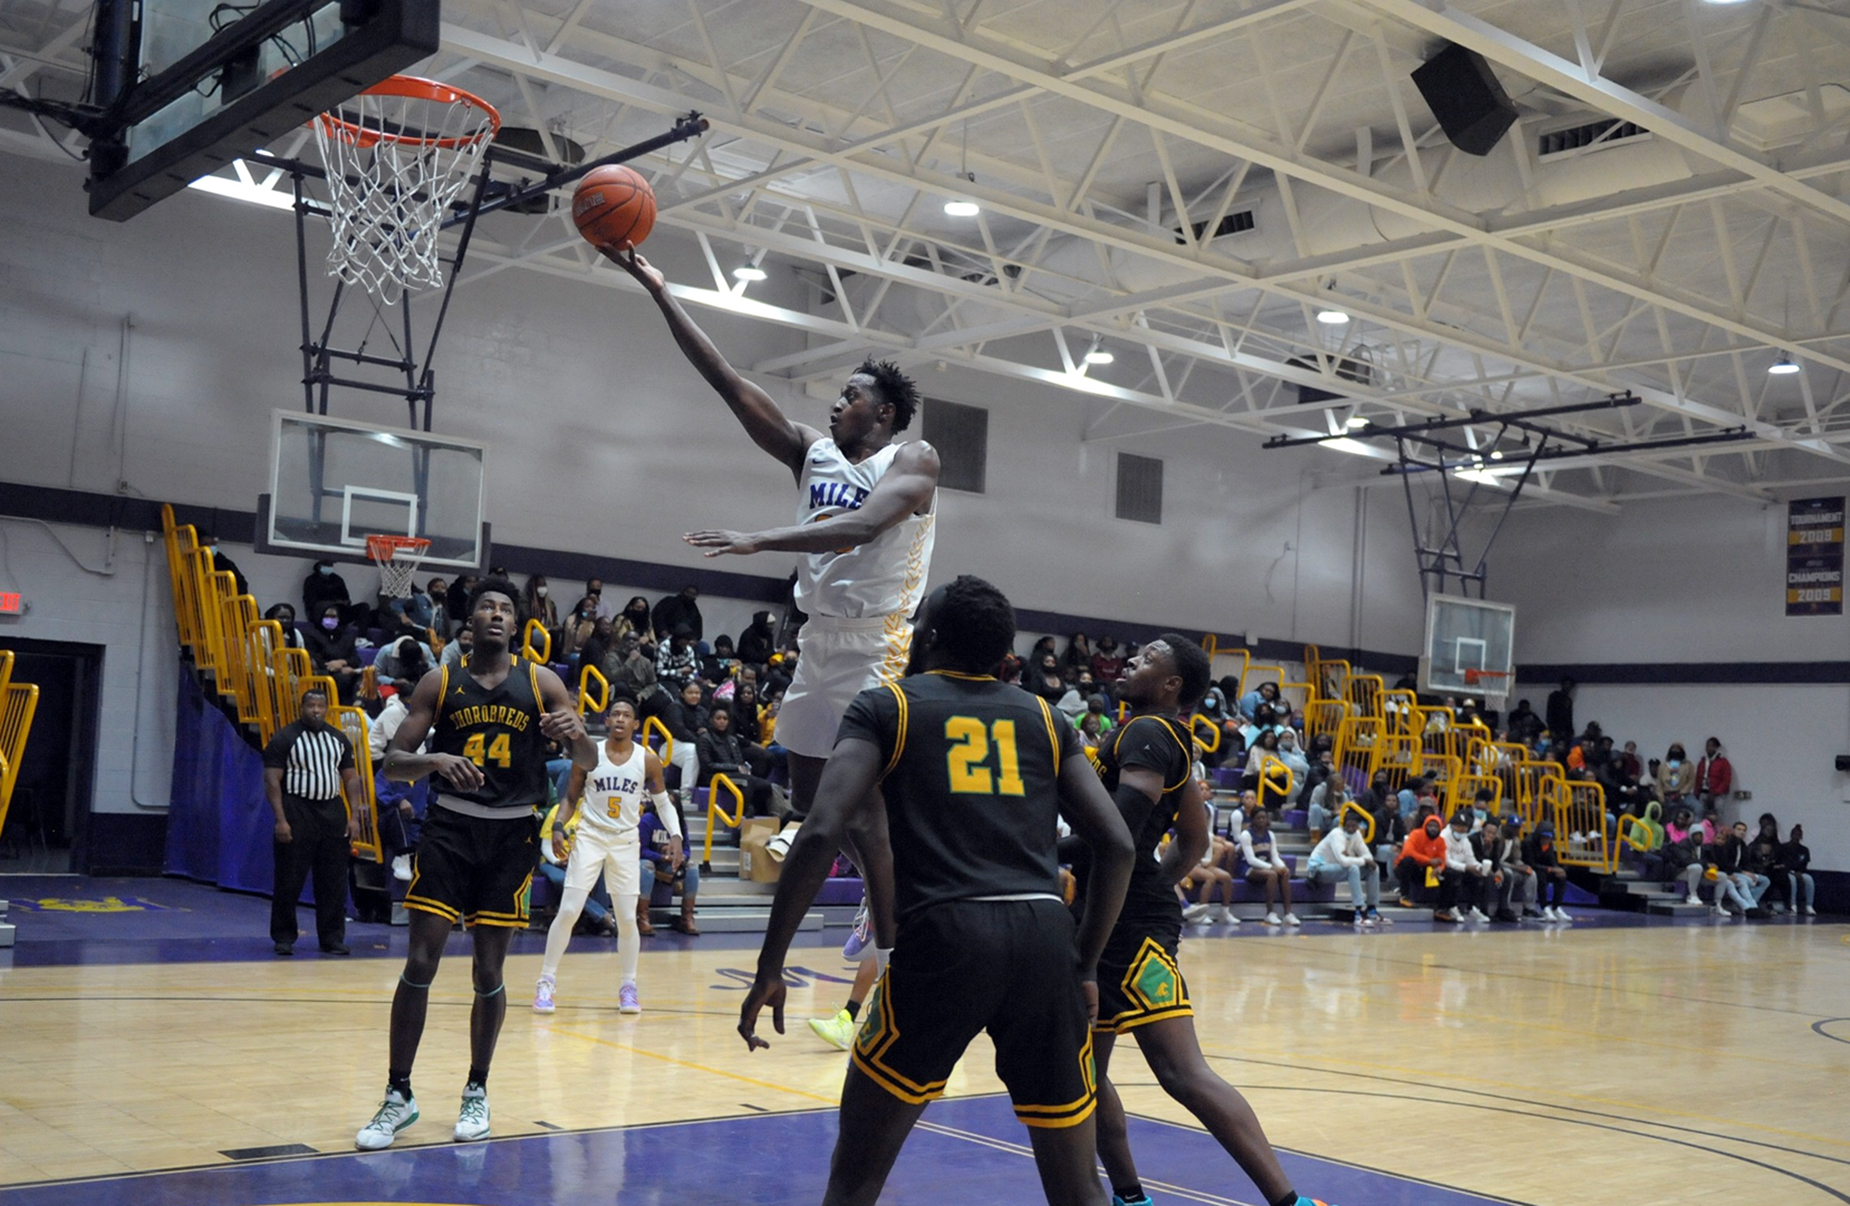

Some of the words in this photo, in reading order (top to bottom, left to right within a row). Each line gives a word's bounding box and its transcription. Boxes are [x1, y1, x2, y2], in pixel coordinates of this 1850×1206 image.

[809, 482, 870, 510] MILE
[1799, 529, 1833, 543] 2009
[1788, 571, 1841, 583] CHAMPIONS
[1797, 589, 1832, 602] 2009
[449, 705, 530, 732] THOROBREDS
[463, 732, 512, 768] 44
[944, 714, 1026, 797] 21
[593, 776, 638, 794] MILES
[607, 796, 622, 819] 5
[652, 829, 671, 844] MIL
